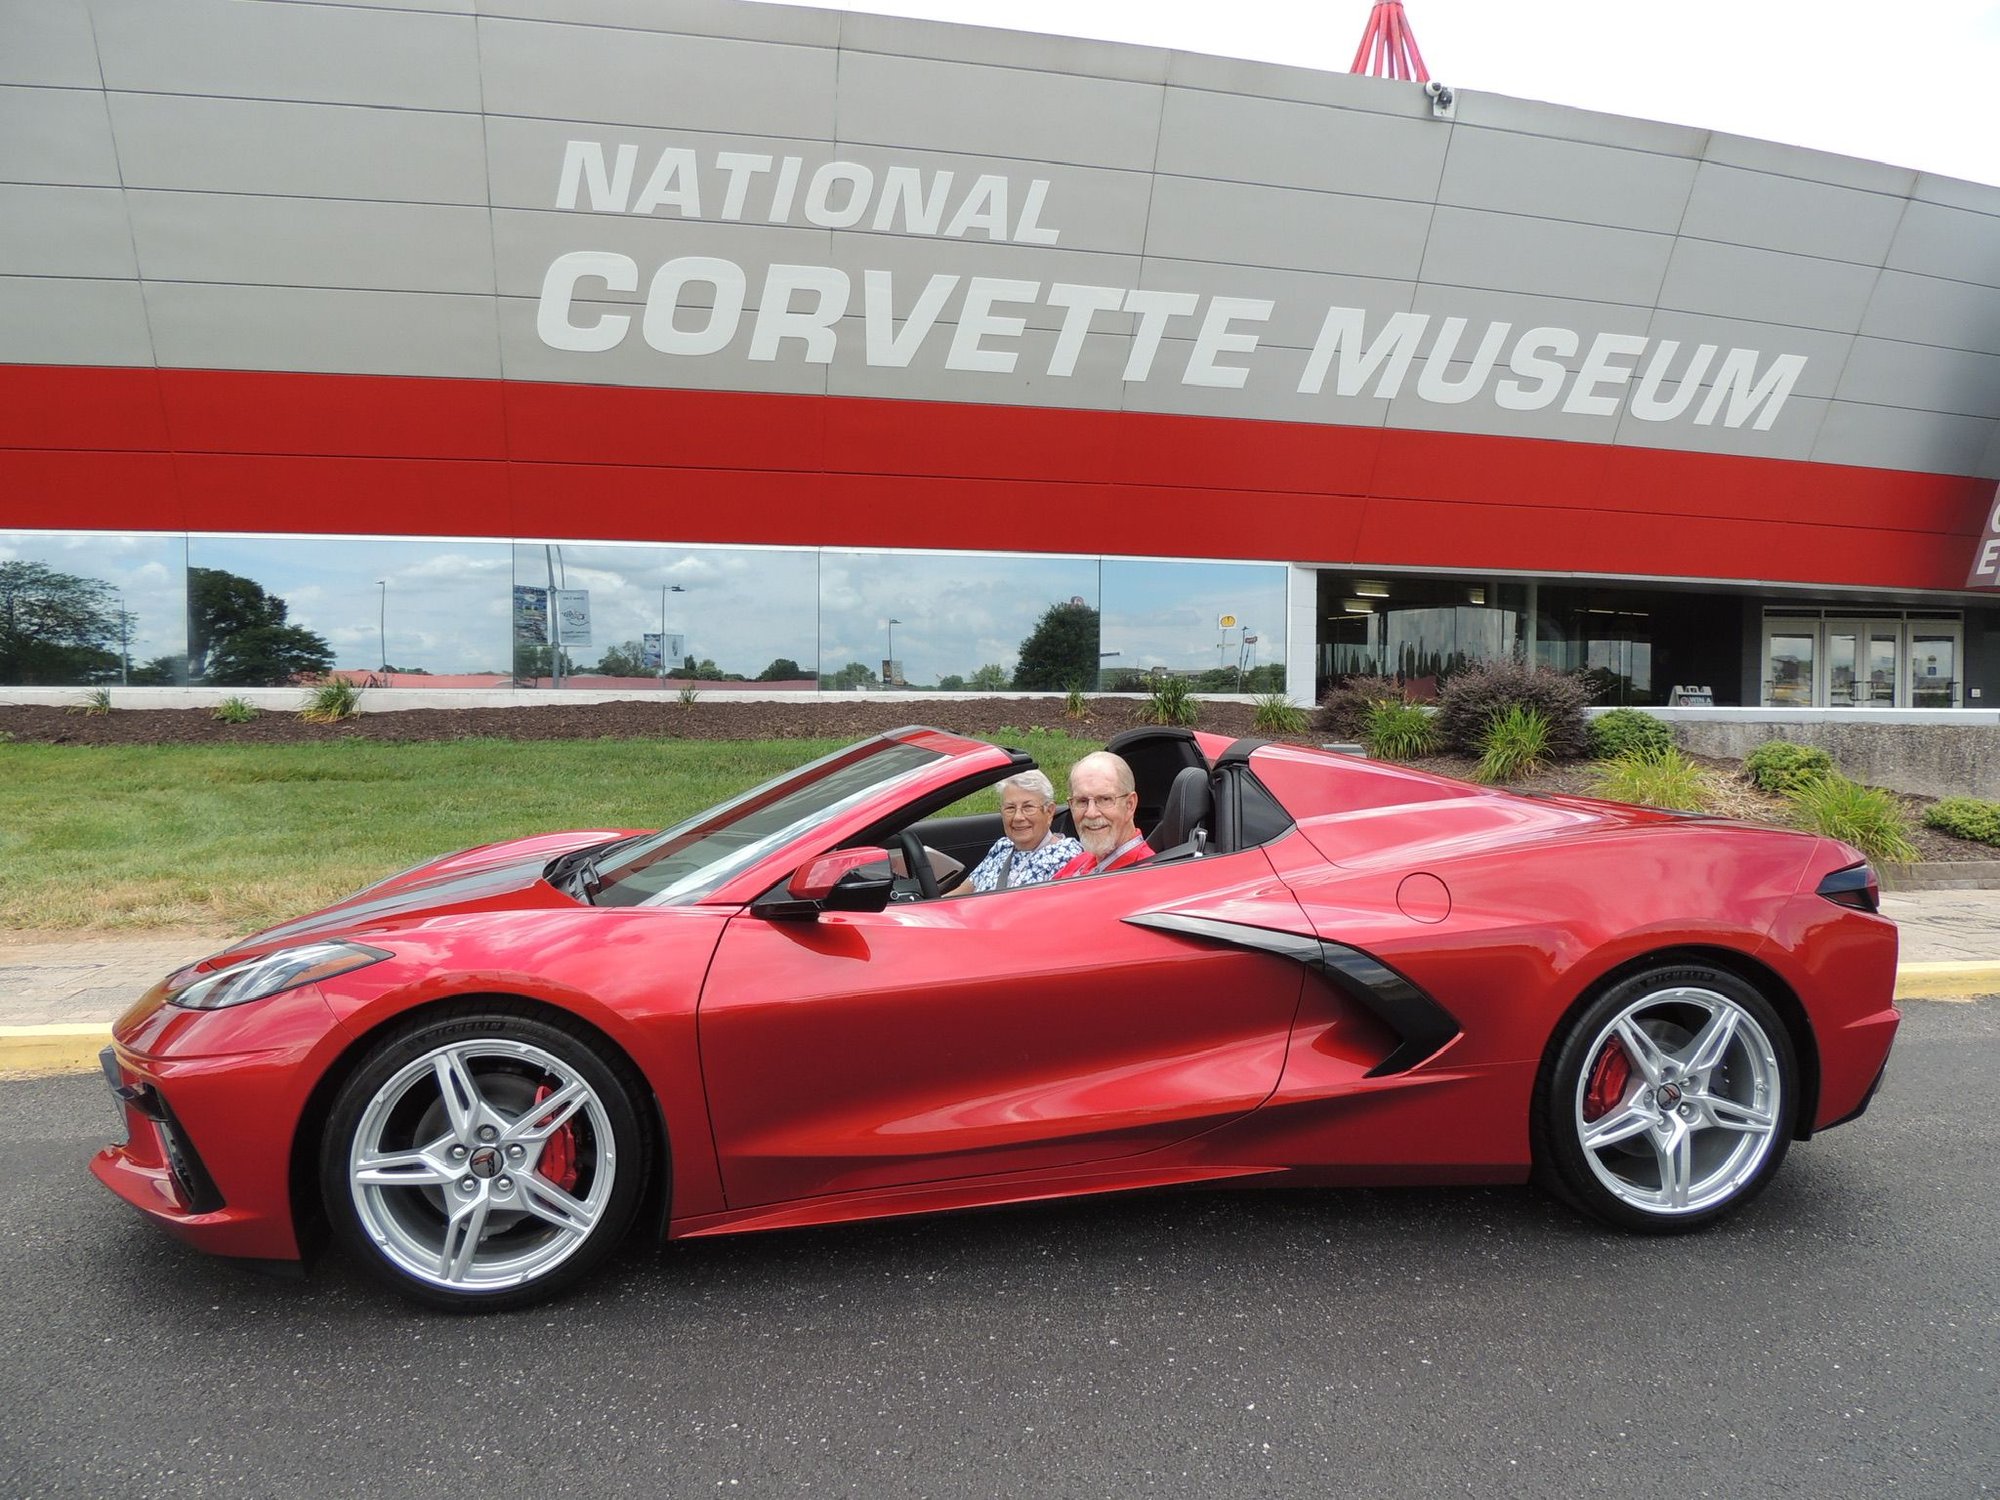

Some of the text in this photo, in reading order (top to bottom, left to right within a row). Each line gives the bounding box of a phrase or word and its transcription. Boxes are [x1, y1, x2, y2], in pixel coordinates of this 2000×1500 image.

[555, 140, 1060, 245] NATIONAL
[537, 251, 1808, 431] CORVETTE MUSEUM
[1648, 971, 1714, 985] MICHELIN
[428, 1021, 502, 1039] MICHELIN
